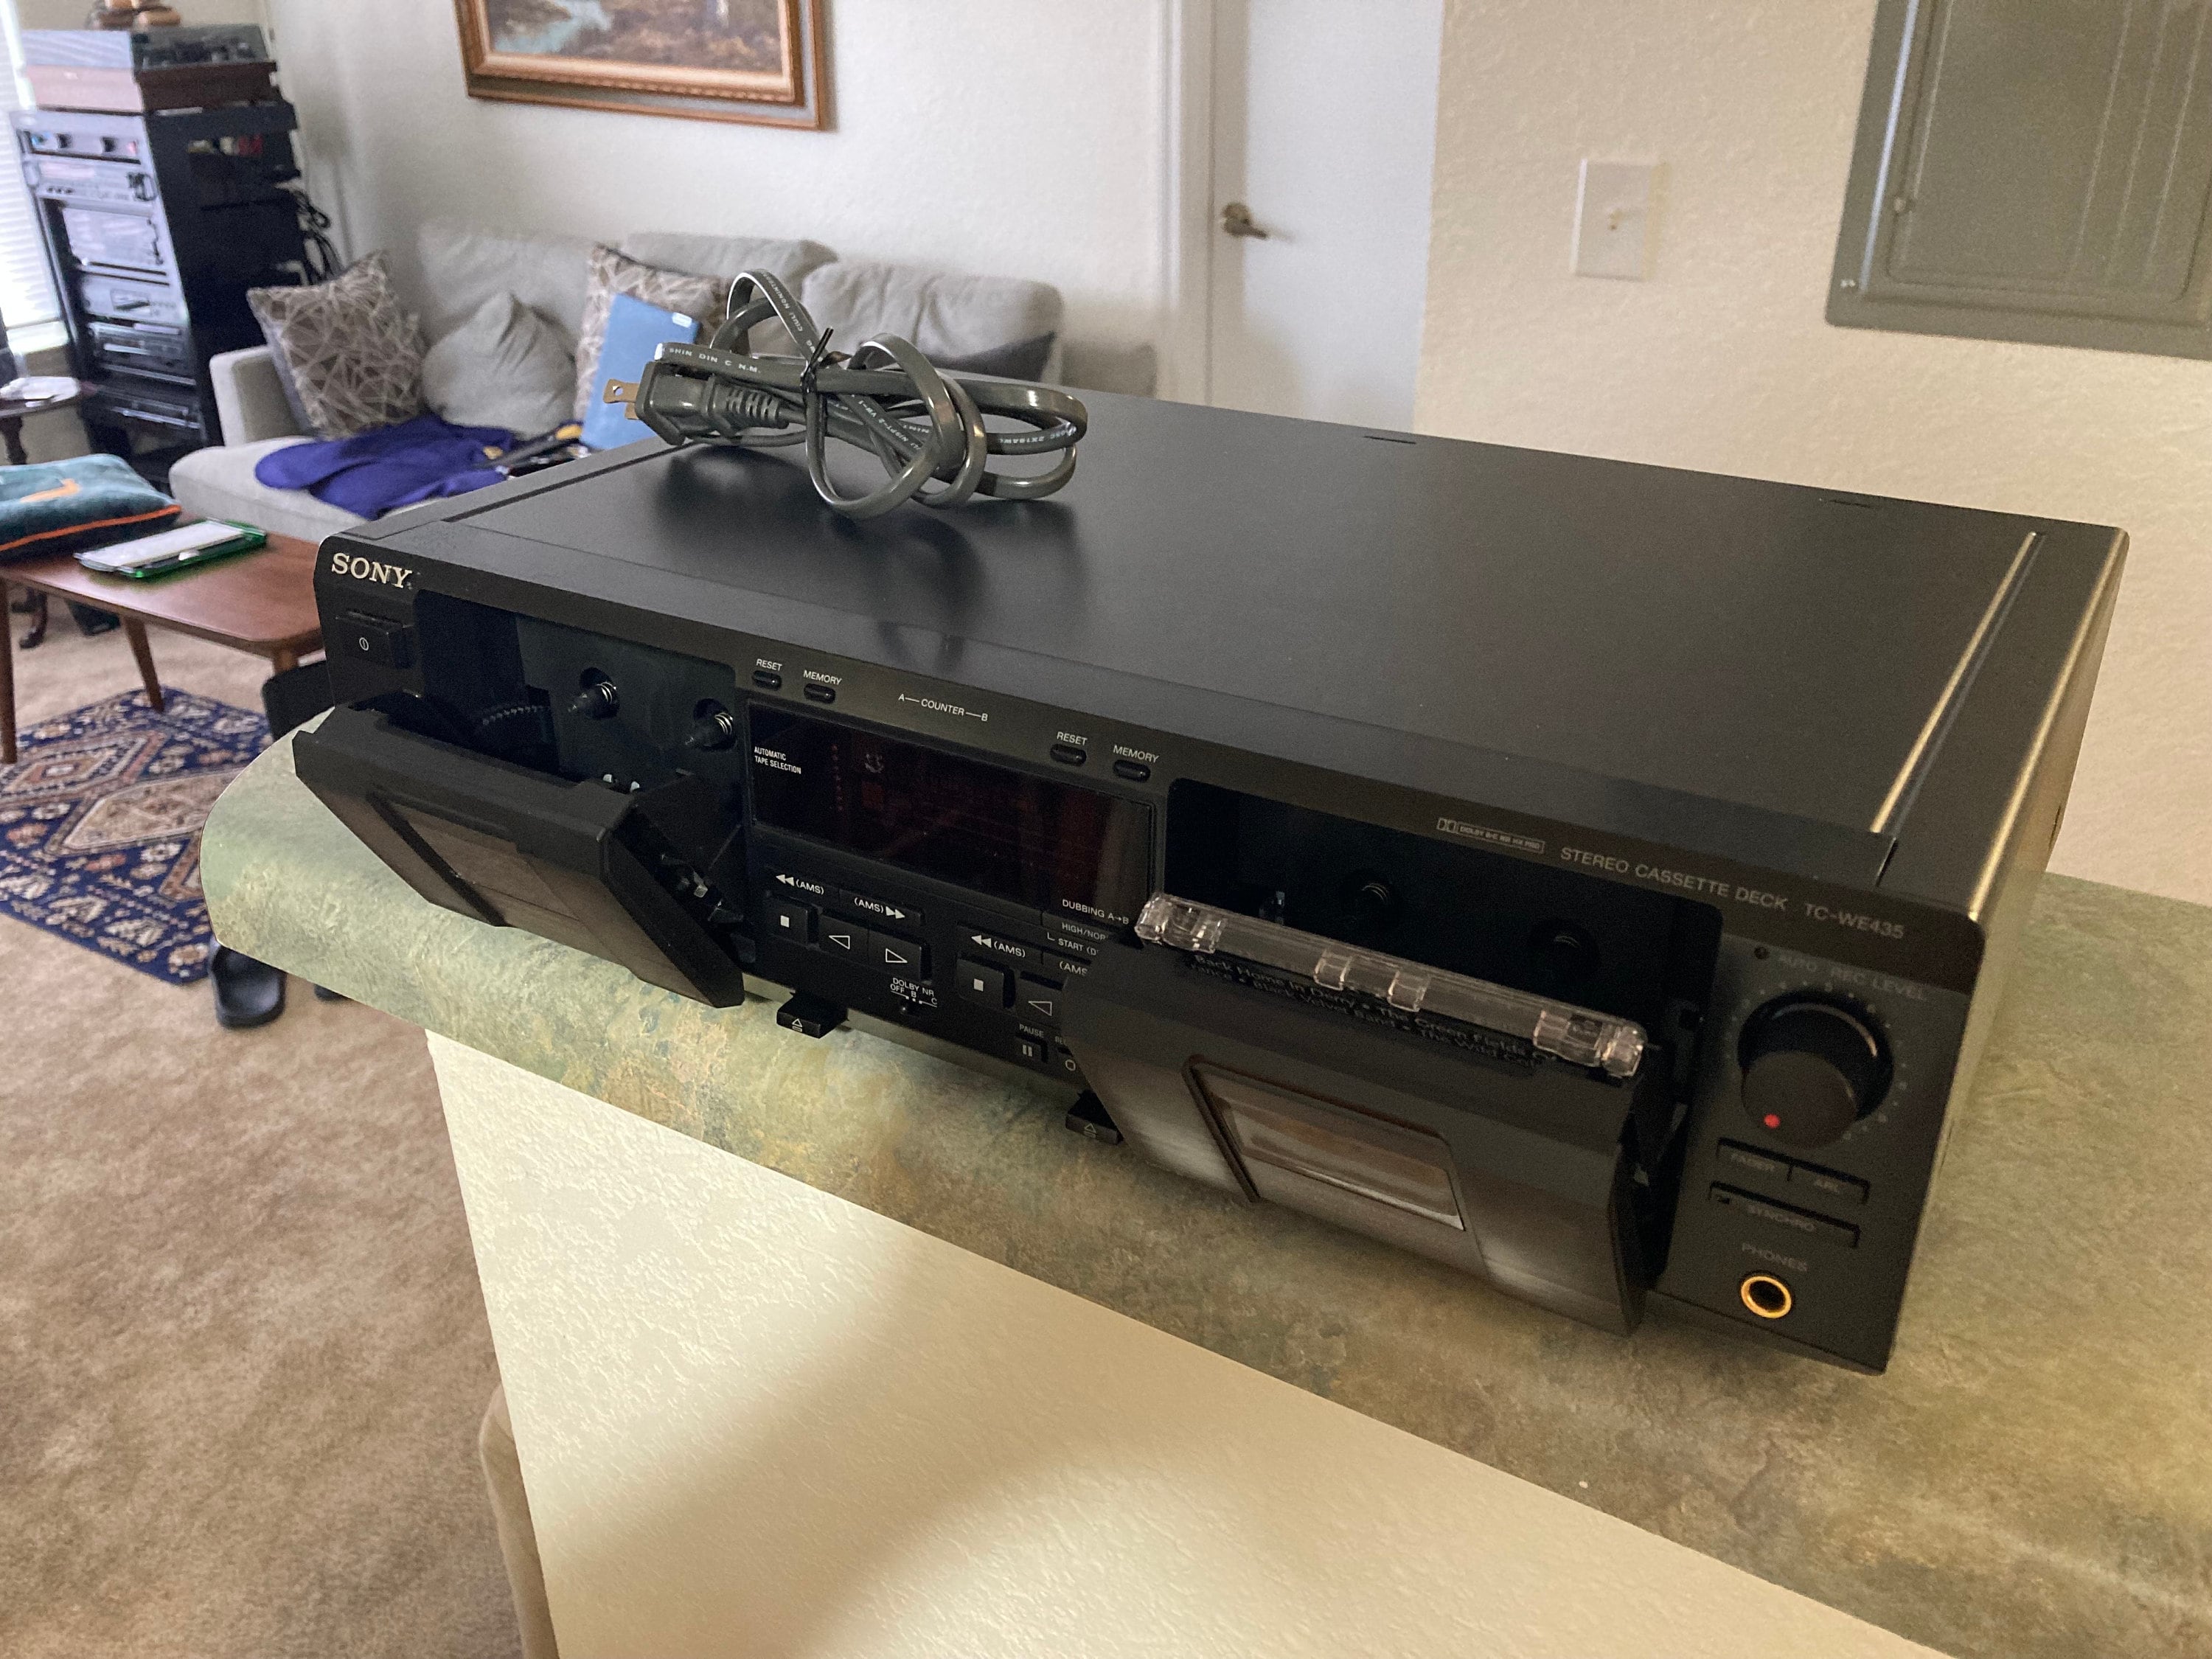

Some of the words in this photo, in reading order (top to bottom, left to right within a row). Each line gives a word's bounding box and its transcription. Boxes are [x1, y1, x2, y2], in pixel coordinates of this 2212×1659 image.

[332, 552, 413, 588] SONY
[756, 658, 782, 672] RESET
[803, 669, 843, 686] MEMORY
[1057, 731, 1088, 746] RESET
[754, 745, 787, 761] AUTOMATIC
[1113, 745, 1160, 763] MEMORY
[754, 755, 769, 766] TAPE
[770, 759, 801, 774] SELECTION
[796, 878, 824, 895] (AMS)
[1560, 847, 1630, 873] STEREO
[1635, 863, 1730, 898] CASSETTE
[1735, 886, 1789, 912] DECK
[1806, 902, 1907, 939] TC-WE435
[853, 897, 885, 914] (AMS)
[1062, 899, 1105, 918] DUBBING
[993, 940, 1026, 959] (AMS)
[1058, 938, 1084, 952] START
[892, 977, 919, 992] DOLBY
[922, 987, 934, 998] NR
[1830, 966, 1865, 986] REC
[1869, 977, 1927, 1001] LEVEL
[890, 983, 905, 993] OFF
[911, 990, 917, 998] B
[931, 997, 938, 1005] C
[1019, 1023, 1045, 1039] PAUSE
[1747, 1203, 1816, 1232] SYNCHRO
[1740, 1242, 1808, 1272] PHONES
